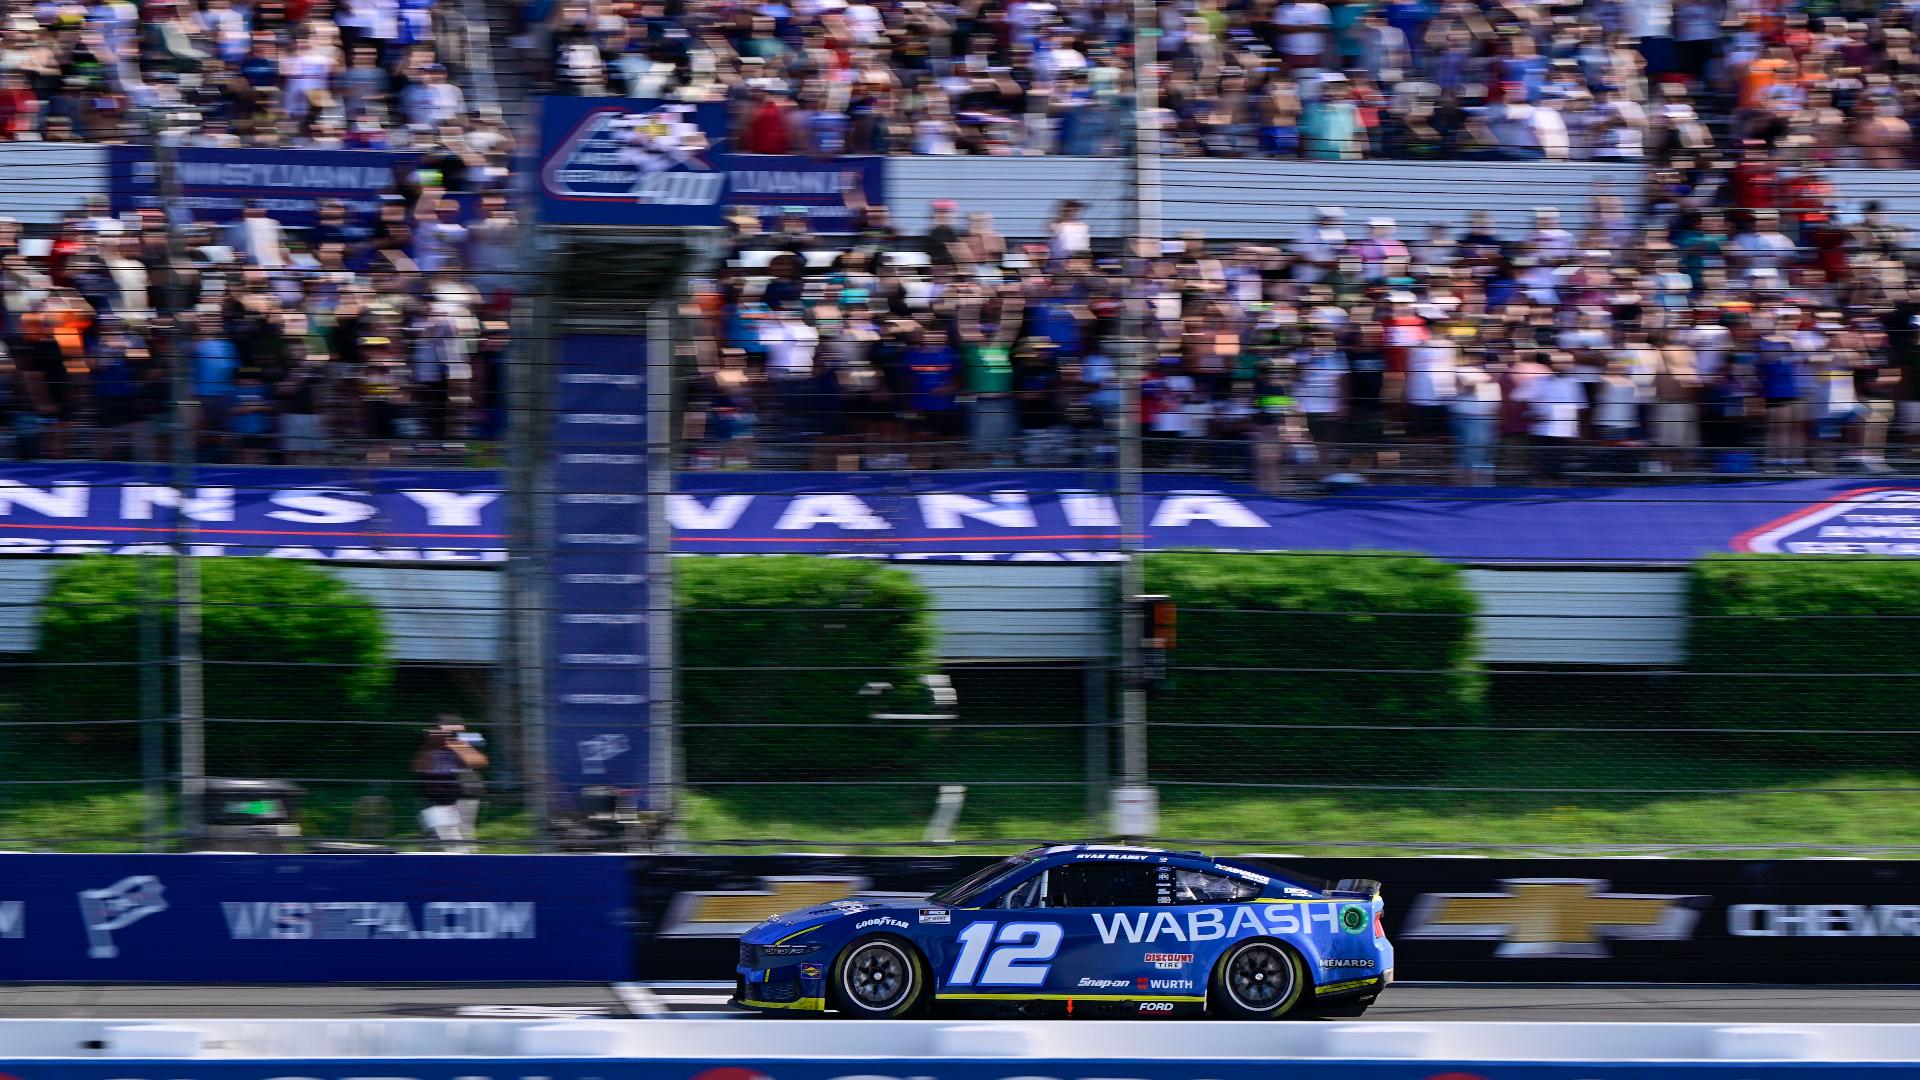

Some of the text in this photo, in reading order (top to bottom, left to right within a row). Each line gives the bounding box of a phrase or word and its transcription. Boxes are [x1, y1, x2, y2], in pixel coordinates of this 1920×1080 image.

[1091, 903, 1339, 944] WABASH
[946, 920, 1064, 986] 12
[1144, 953, 1194, 963] DISCOUNT
[1319, 959, 1375, 967] MENARDS
[1077, 977, 1131, 988] Snap-on
[1139, 1002, 1174, 1011] FORD
